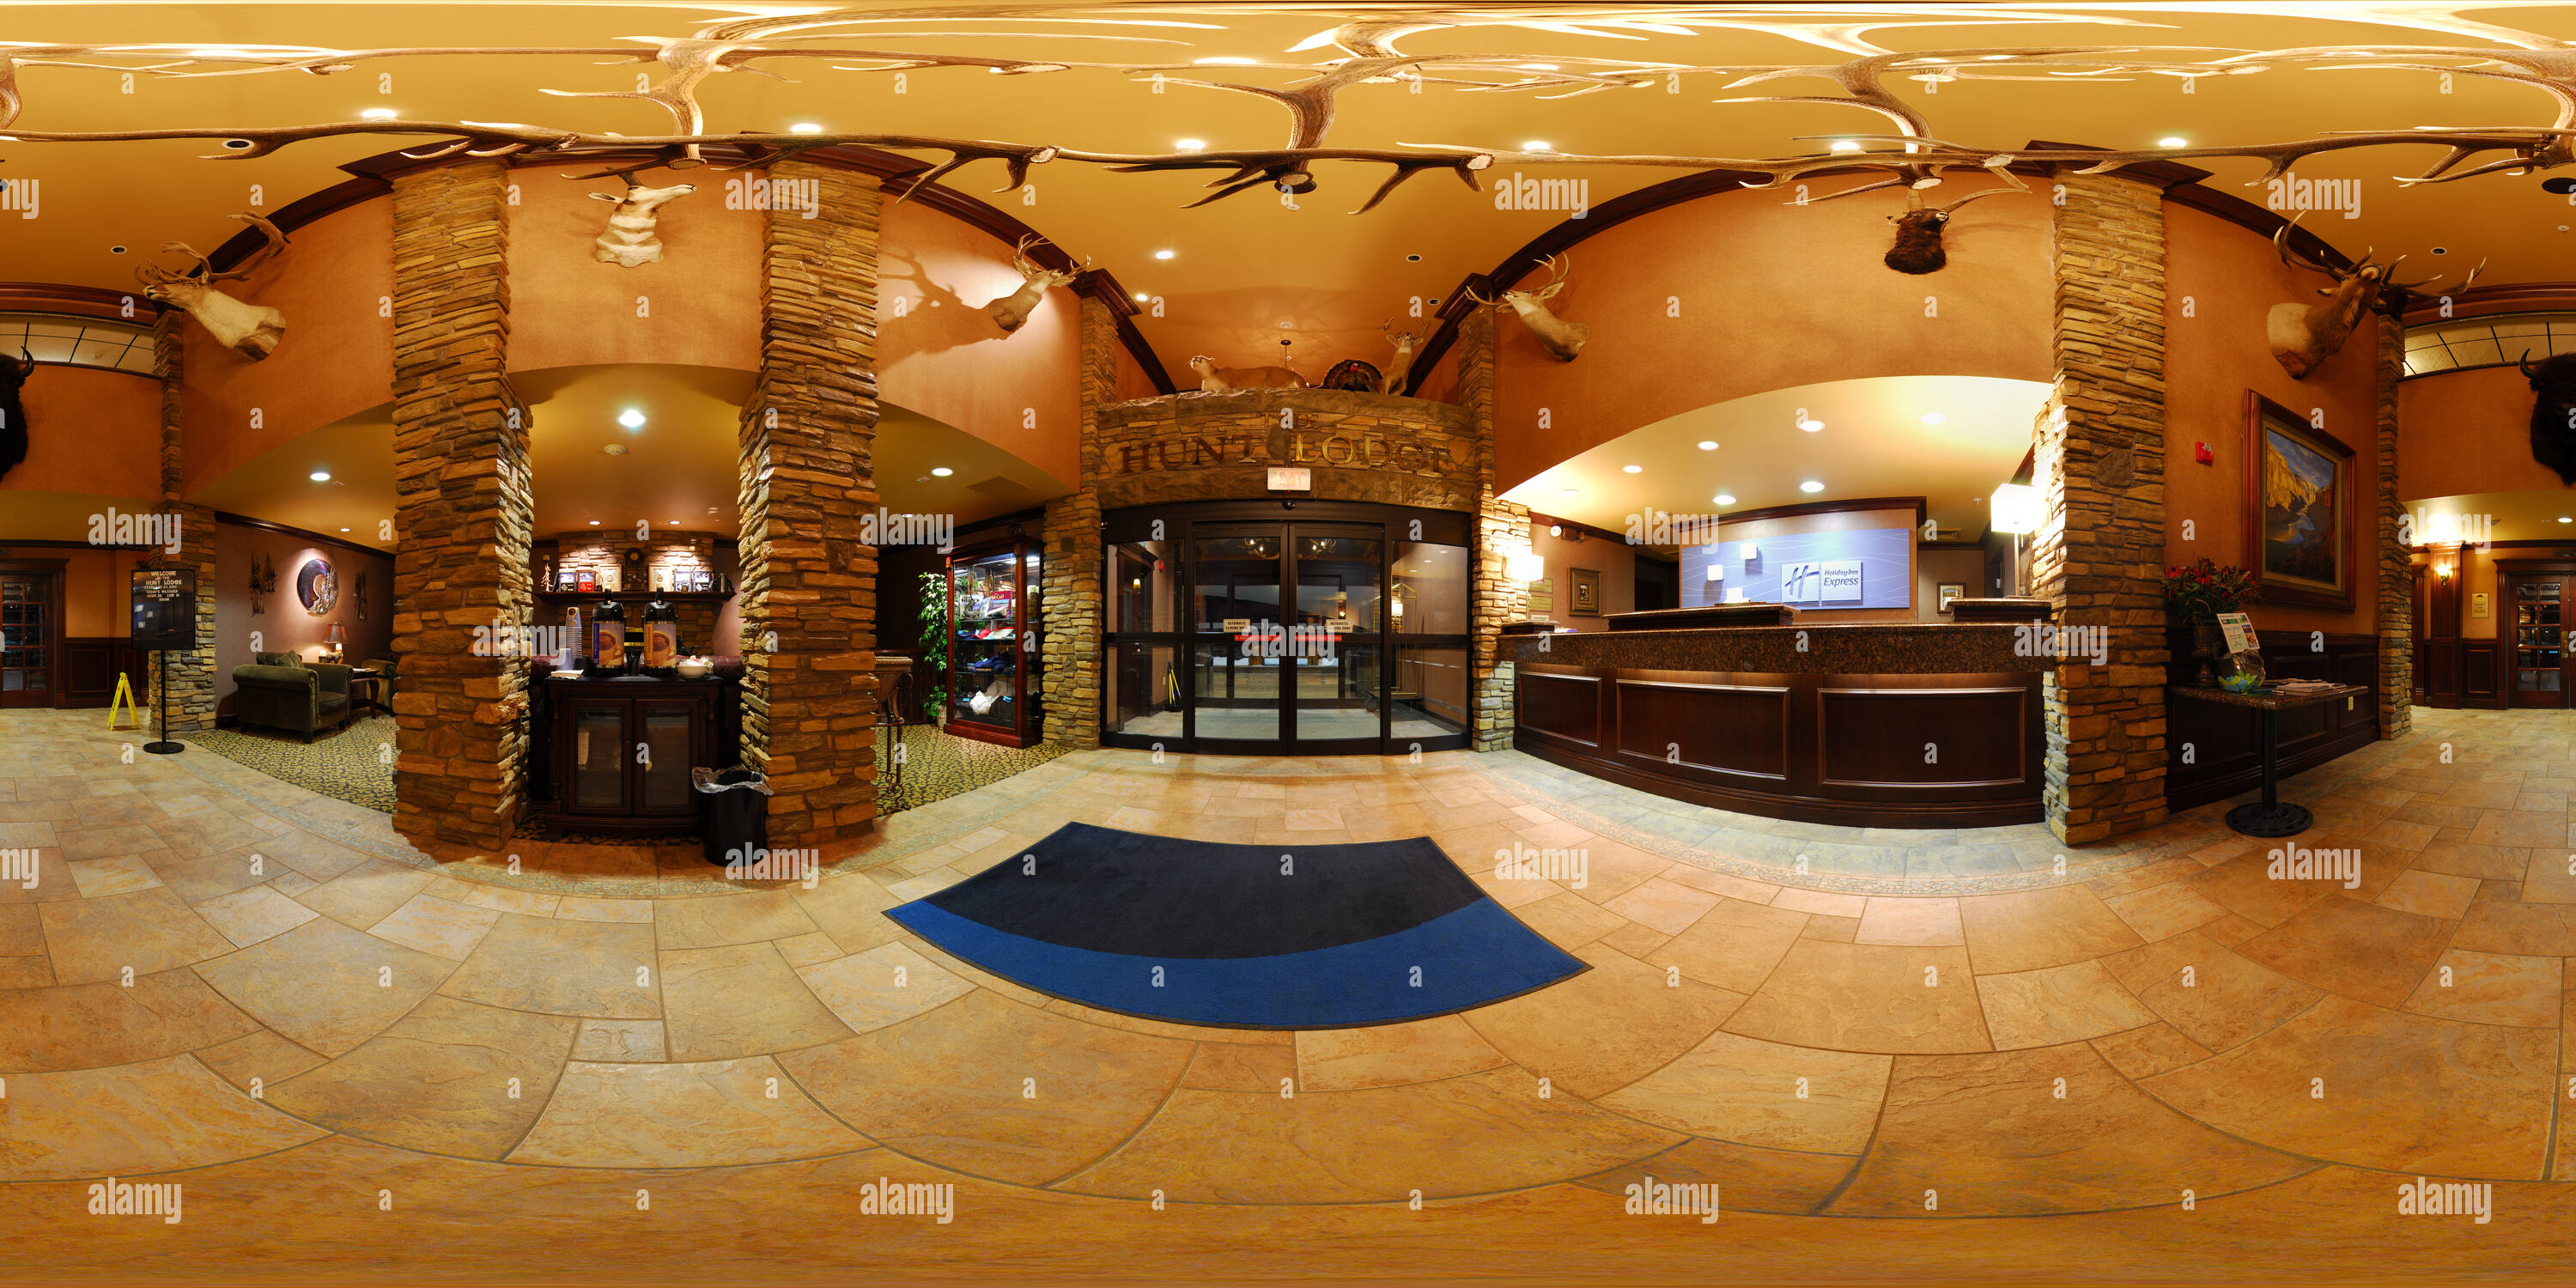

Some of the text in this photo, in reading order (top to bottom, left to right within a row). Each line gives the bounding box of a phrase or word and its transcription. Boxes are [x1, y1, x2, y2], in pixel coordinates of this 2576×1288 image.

[1119, 432, 1451, 477] HUNT LODGE
[1823, 577, 1859, 588] Express
